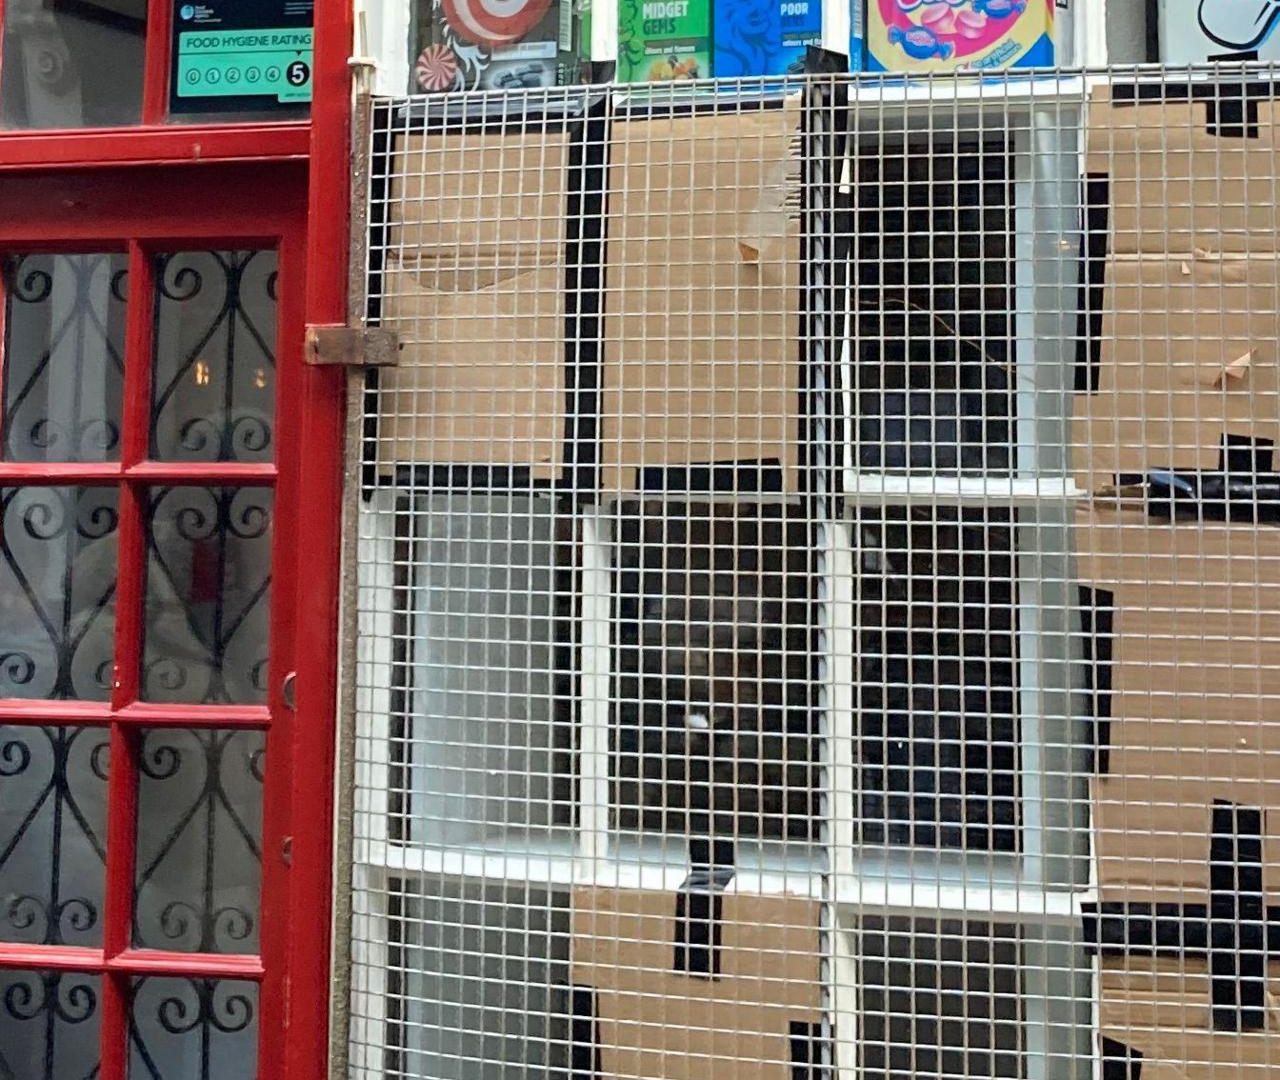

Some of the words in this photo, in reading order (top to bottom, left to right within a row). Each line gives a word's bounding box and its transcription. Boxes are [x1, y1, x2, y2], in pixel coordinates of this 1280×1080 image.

[642, 0, 689, 20] MIDGET
[780, 2, 809, 16] POOR
[643, 19, 676, 35] GEMS
[186, 37, 220, 48] FOOD
[222, 35, 269, 47] HYGIENE
[271, 34, 312, 45] RATING
[291, 64, 305, 84] 5
